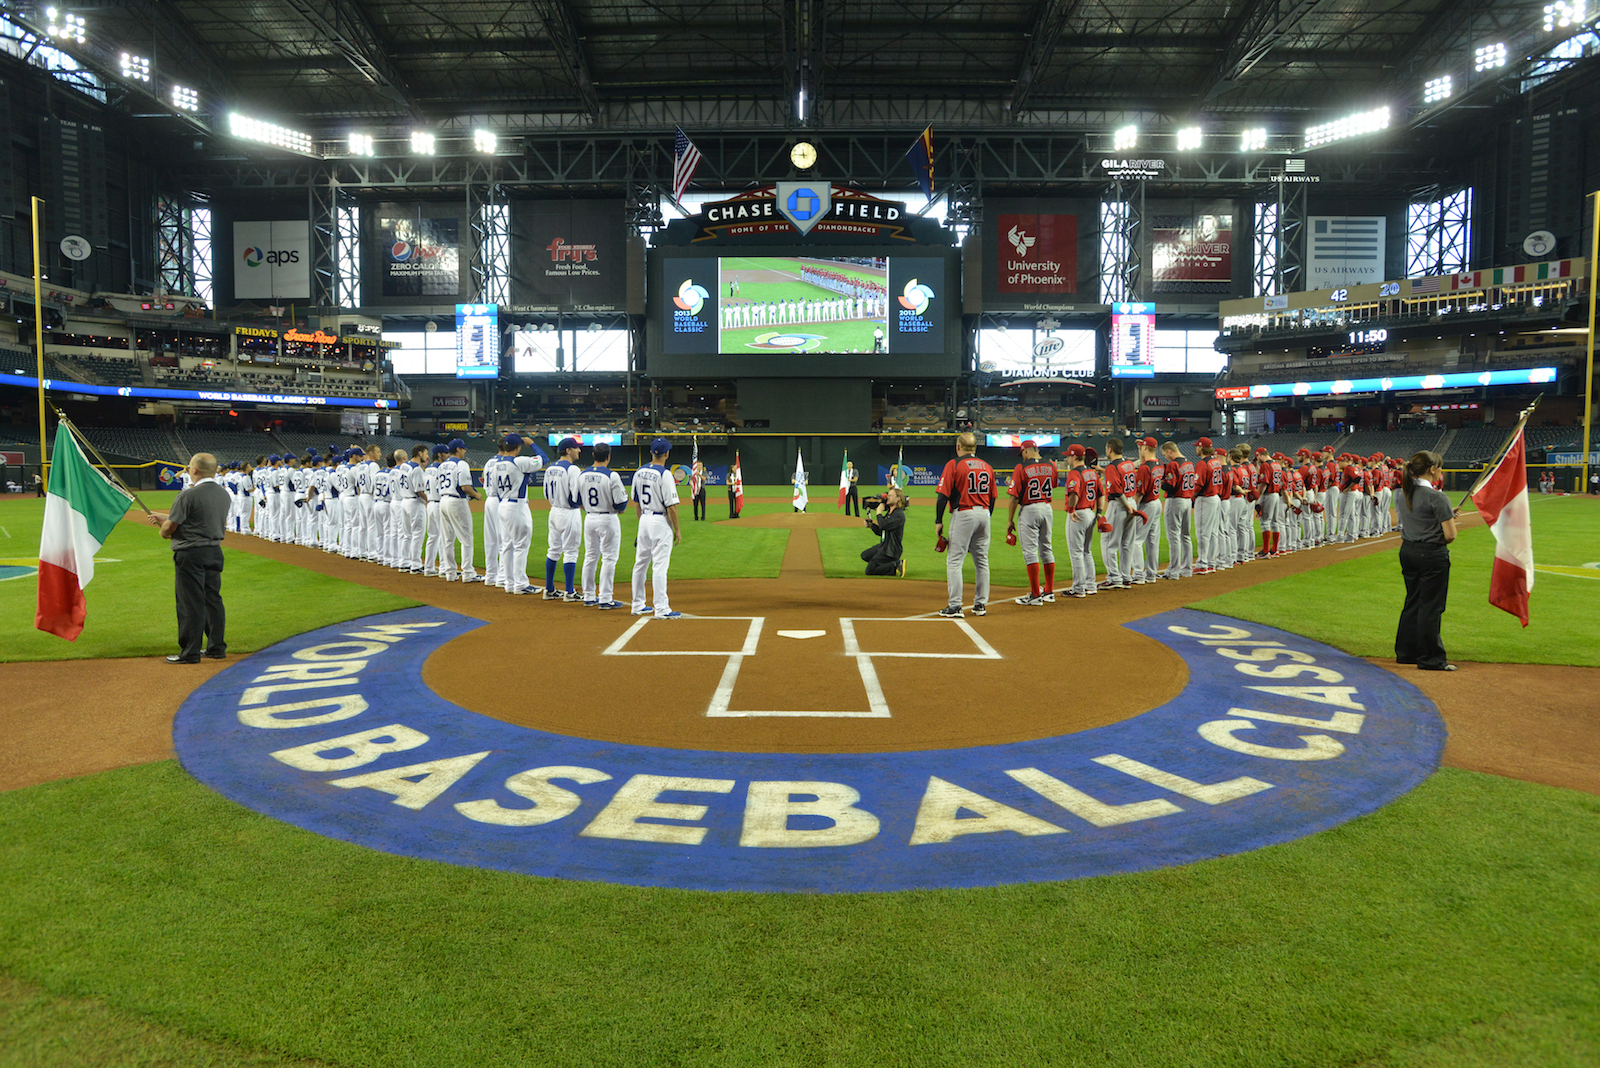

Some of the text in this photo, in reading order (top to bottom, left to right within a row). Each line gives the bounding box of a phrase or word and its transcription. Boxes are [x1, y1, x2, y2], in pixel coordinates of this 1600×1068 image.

[707, 203, 899, 222] CHASE FIELD
[731, 226, 753, 234] HOME
[818, 224, 876, 233] DIAMONDBACKS
[266, 250, 299, 267] aps
[546, 237, 598, 263] fry's
[1007, 261, 1061, 274] University
[1007, 273, 1063, 285] of Phoenix
[1330, 288, 1349, 302] 42
[1379, 282, 1400, 297] 20
[1041, 303, 1075, 312] Champions
[235, 327, 278, 338] FRIDAY'S
[1349, 329, 1388, 343] 11:50
[342, 336, 403, 348] SPORTS GRILL
[1002, 368, 1095, 378] DIAMOND CLUB
[198, 391, 231, 400] WORLD
[231, 393, 273, 402] BASEBALL
[273, 395, 306, 404] CLASSIC
[439, 472, 451, 490] 25
[497, 474, 513, 492] 44
[967, 471, 990, 495] 12
[1028, 477, 1053, 500] 24
[1124, 473, 1136, 493] 19
[1182, 473, 1195, 491] 20
[588, 487, 599, 507] 8
[642, 484, 651, 505] 5
[1086, 481, 1096, 502] 5
[236, 620, 1367, 850] WORLD BASEBALL CLASSIC
